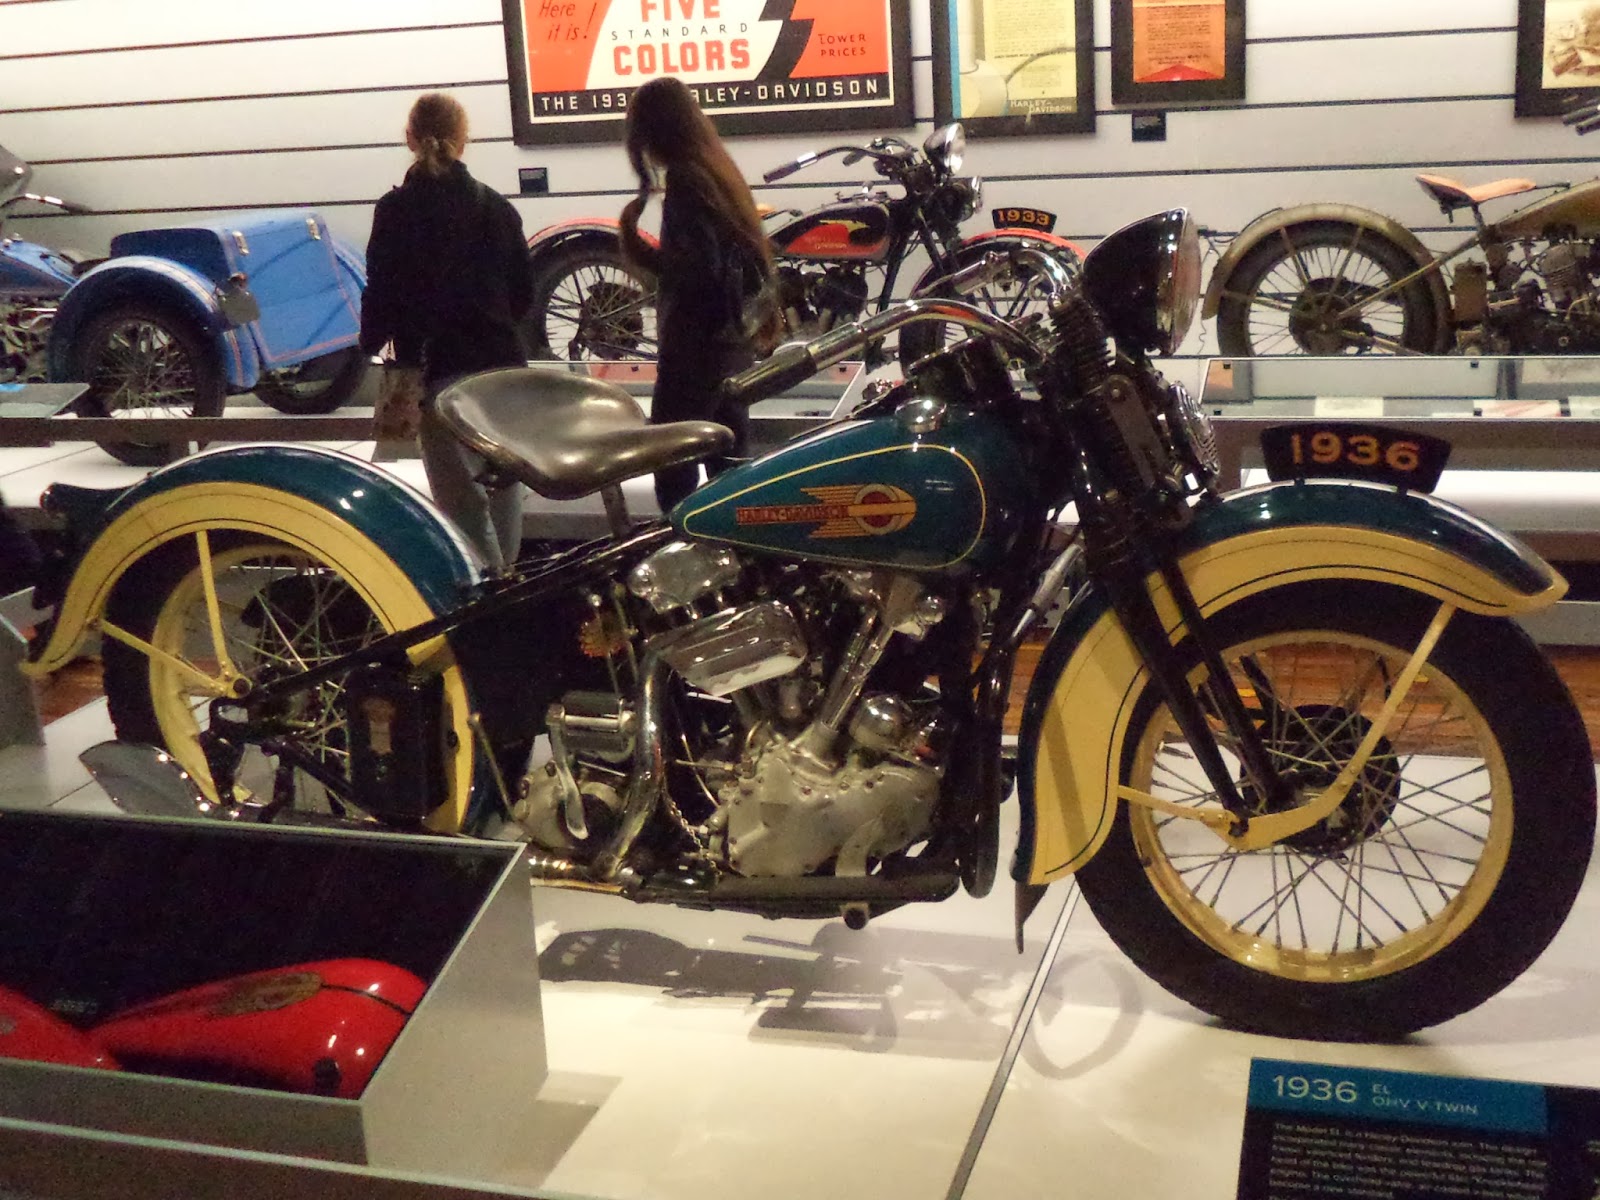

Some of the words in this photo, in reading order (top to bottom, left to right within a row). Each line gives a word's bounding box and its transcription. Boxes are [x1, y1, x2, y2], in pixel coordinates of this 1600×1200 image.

[539, 3, 576, 19] Here
[641, 0, 720, 22] FIVE
[548, 24, 561, 41] it
[611, 22, 748, 41] STANDARD
[613, 38, 750, 76] COLORS
[820, 46, 867, 57] PRICES
[541, 95, 579, 111] THE
[593, 92, 627, 109] 193
[690, 79, 878, 104] RLEY-DAVIDSON
[998, 209, 1050, 226] 1933
[1291, 431, 1420, 471] 1936
[1273, 1074, 1358, 1103] 1936
[1372, 1083, 1391, 1095] EL
